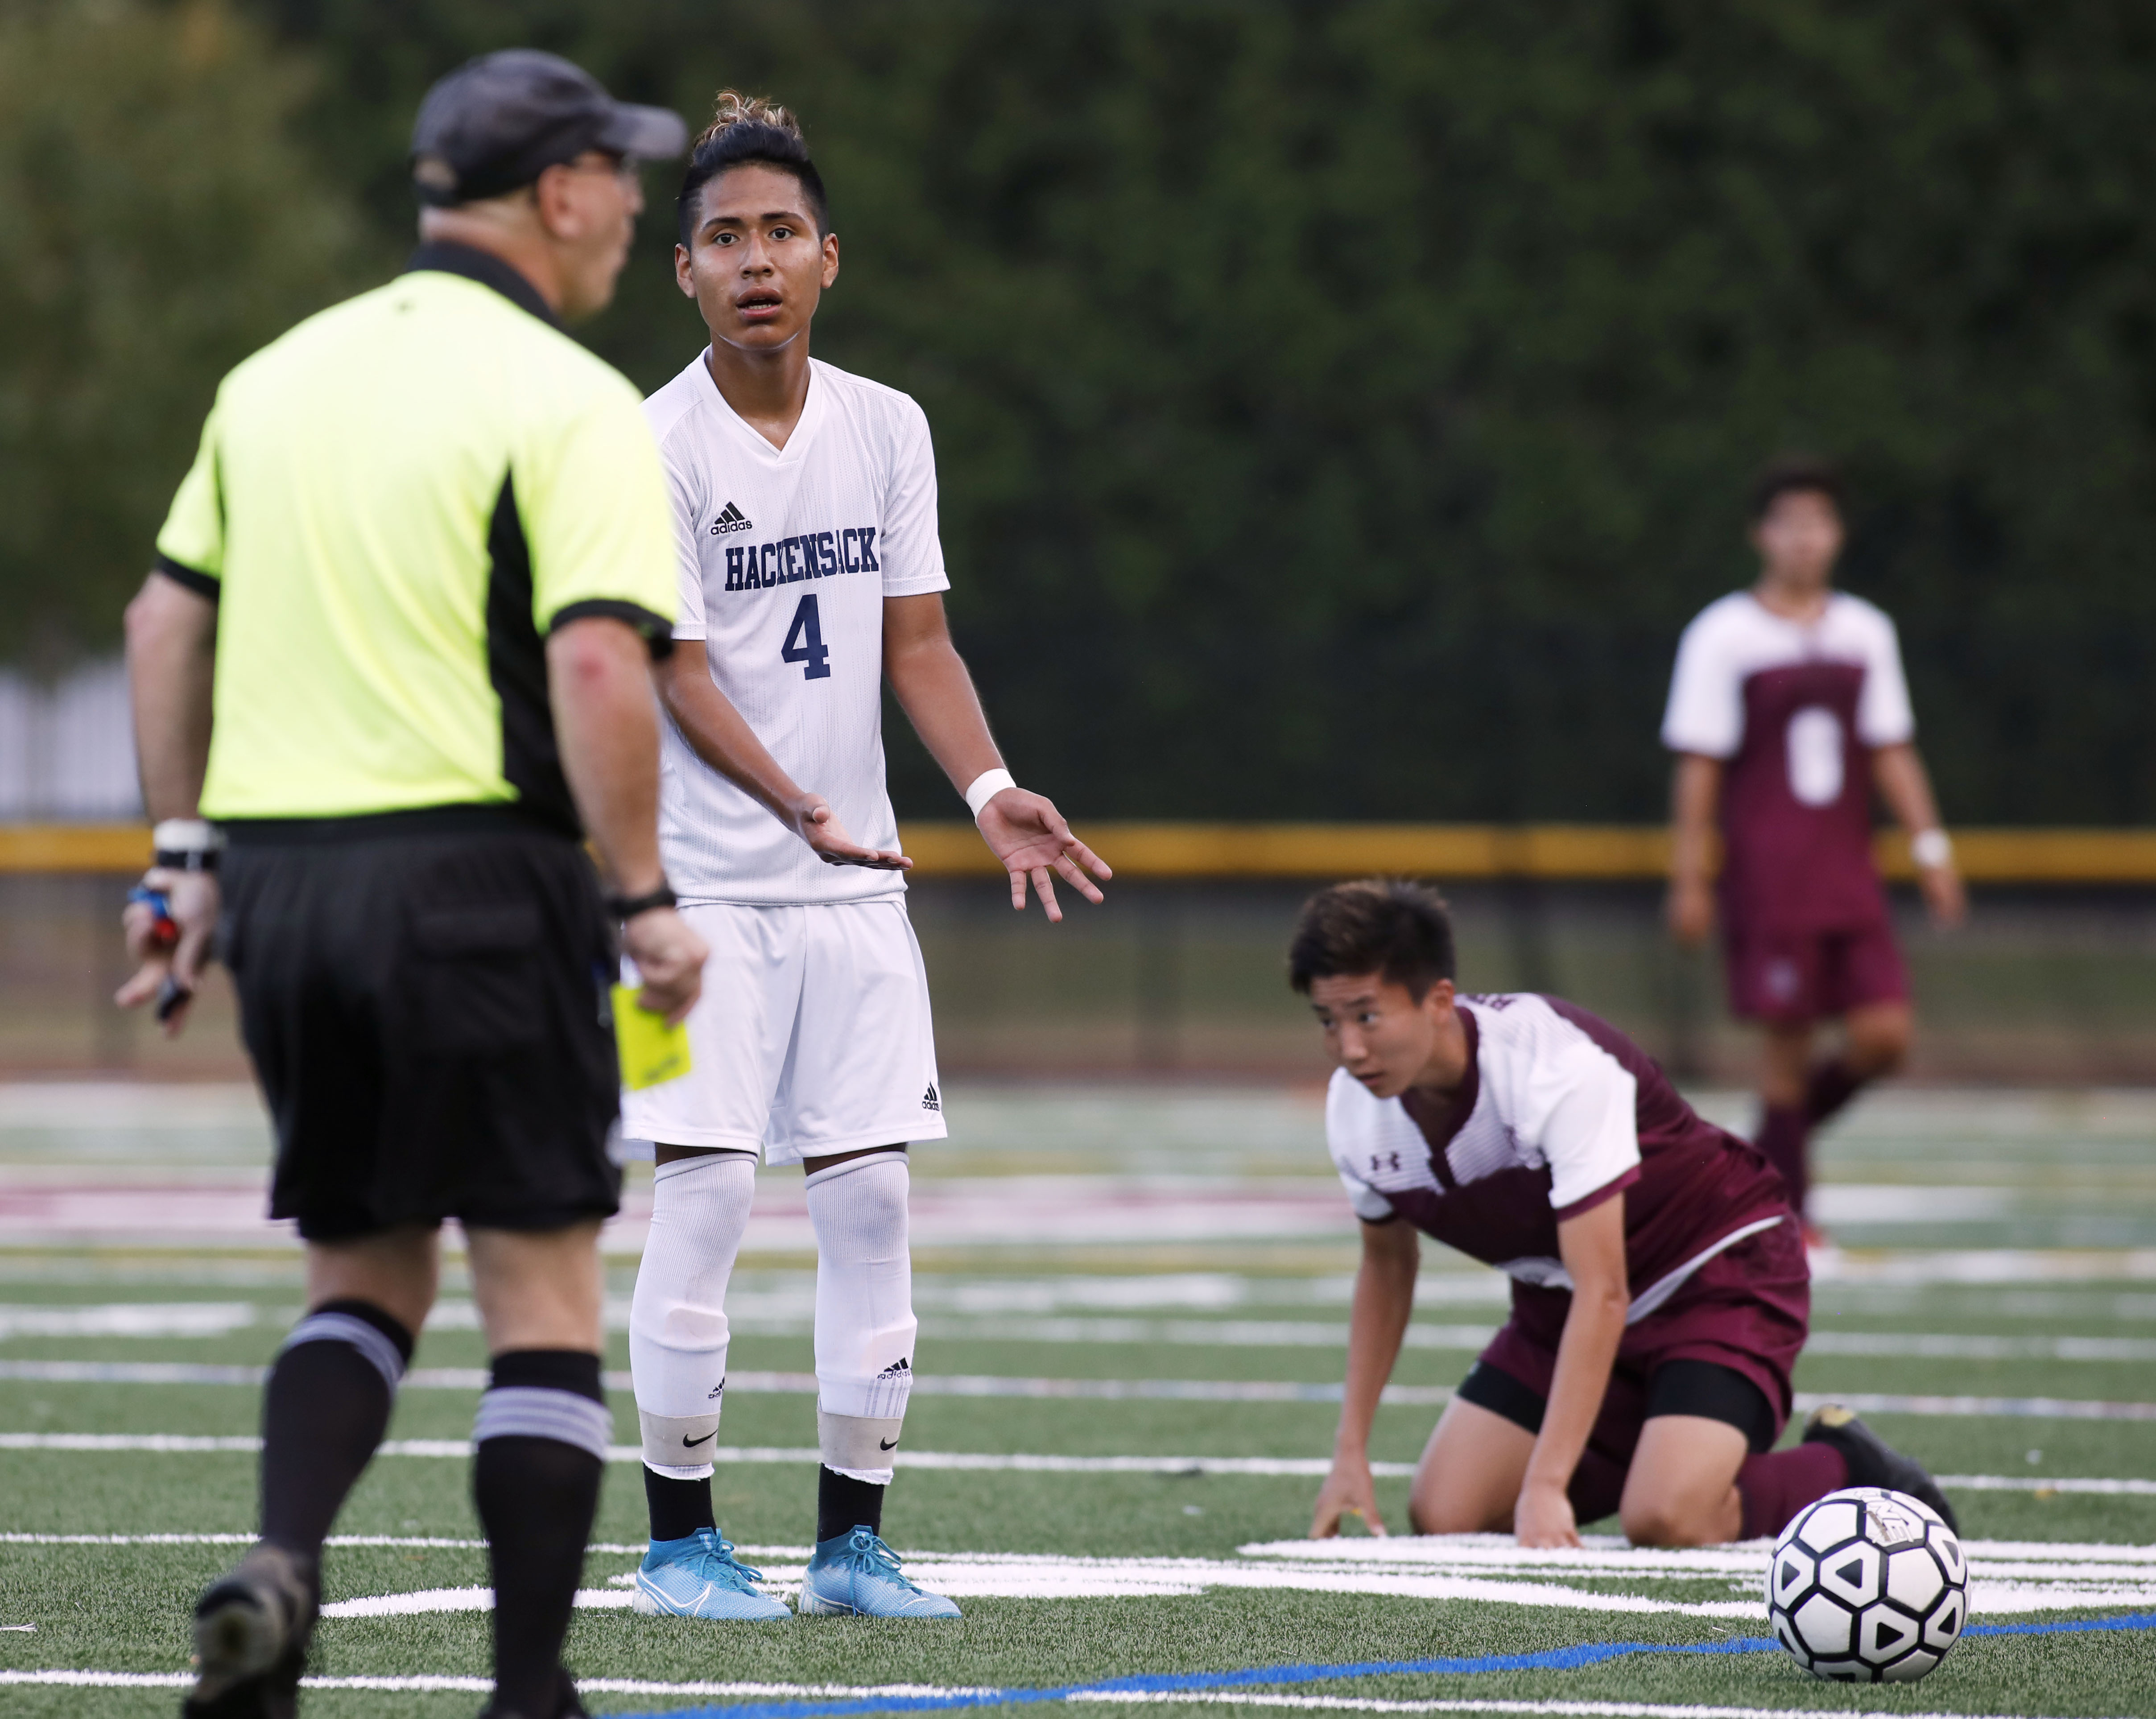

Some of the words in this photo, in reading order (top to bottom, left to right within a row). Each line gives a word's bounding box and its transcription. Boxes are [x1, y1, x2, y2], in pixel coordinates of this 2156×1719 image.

[710, 520, 752, 535] adidas
[781, 594, 830, 680] 4
[877, 1369, 910, 1379] adidas
